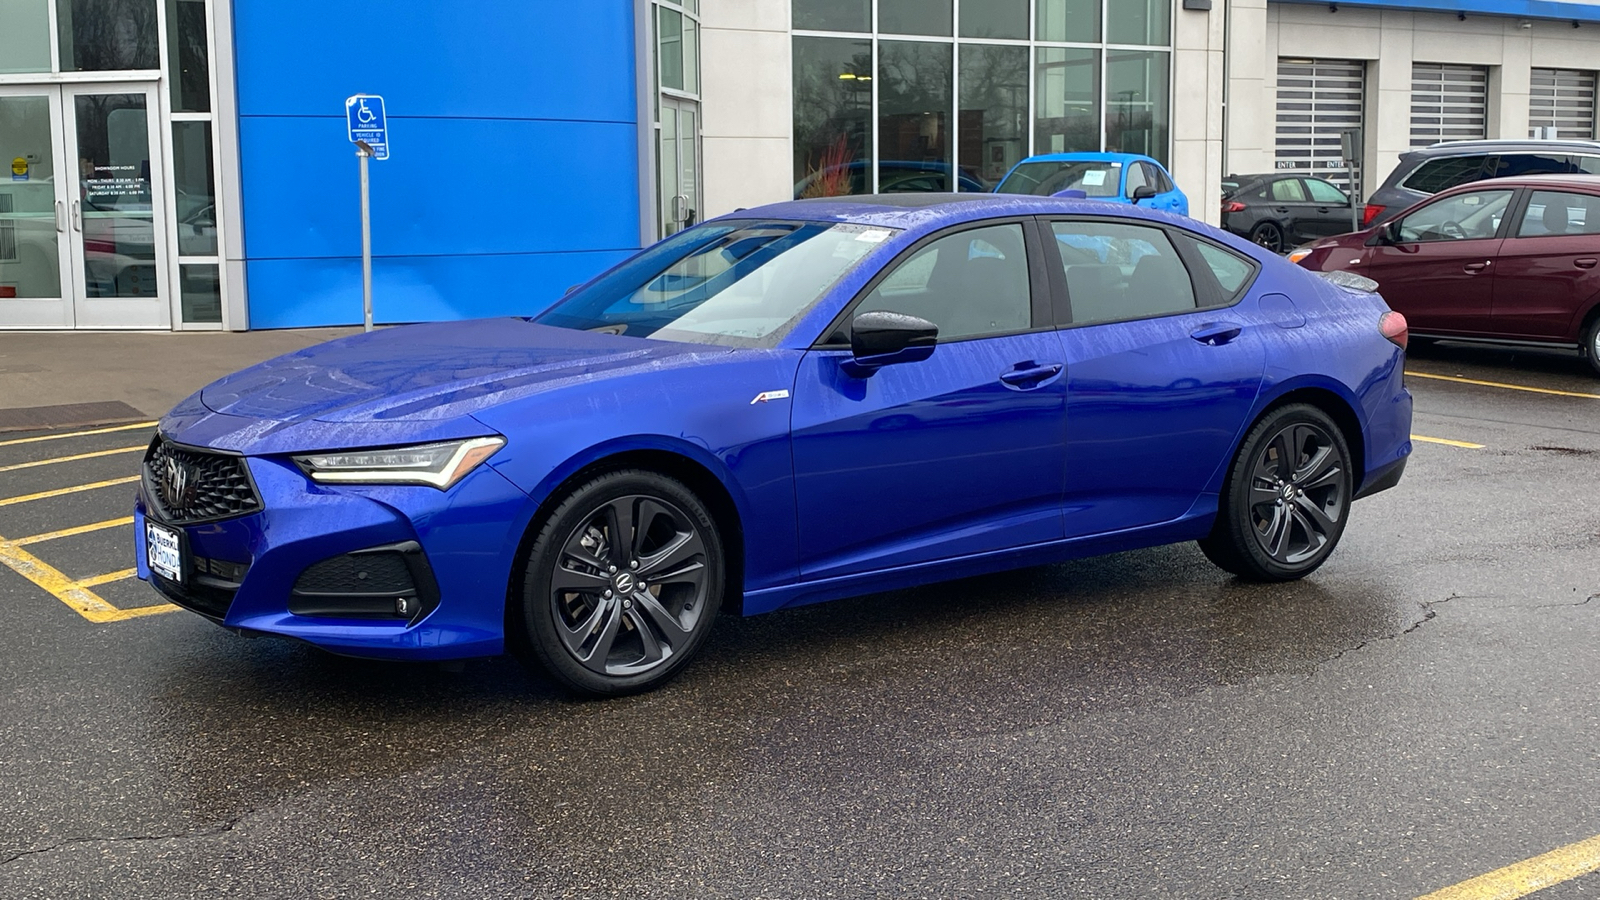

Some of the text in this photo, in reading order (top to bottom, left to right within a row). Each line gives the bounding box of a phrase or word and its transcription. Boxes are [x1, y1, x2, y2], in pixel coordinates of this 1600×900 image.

[1277, 161, 1345, 169] ENTER ENTER
[156, 532, 178, 551] BUERKL
